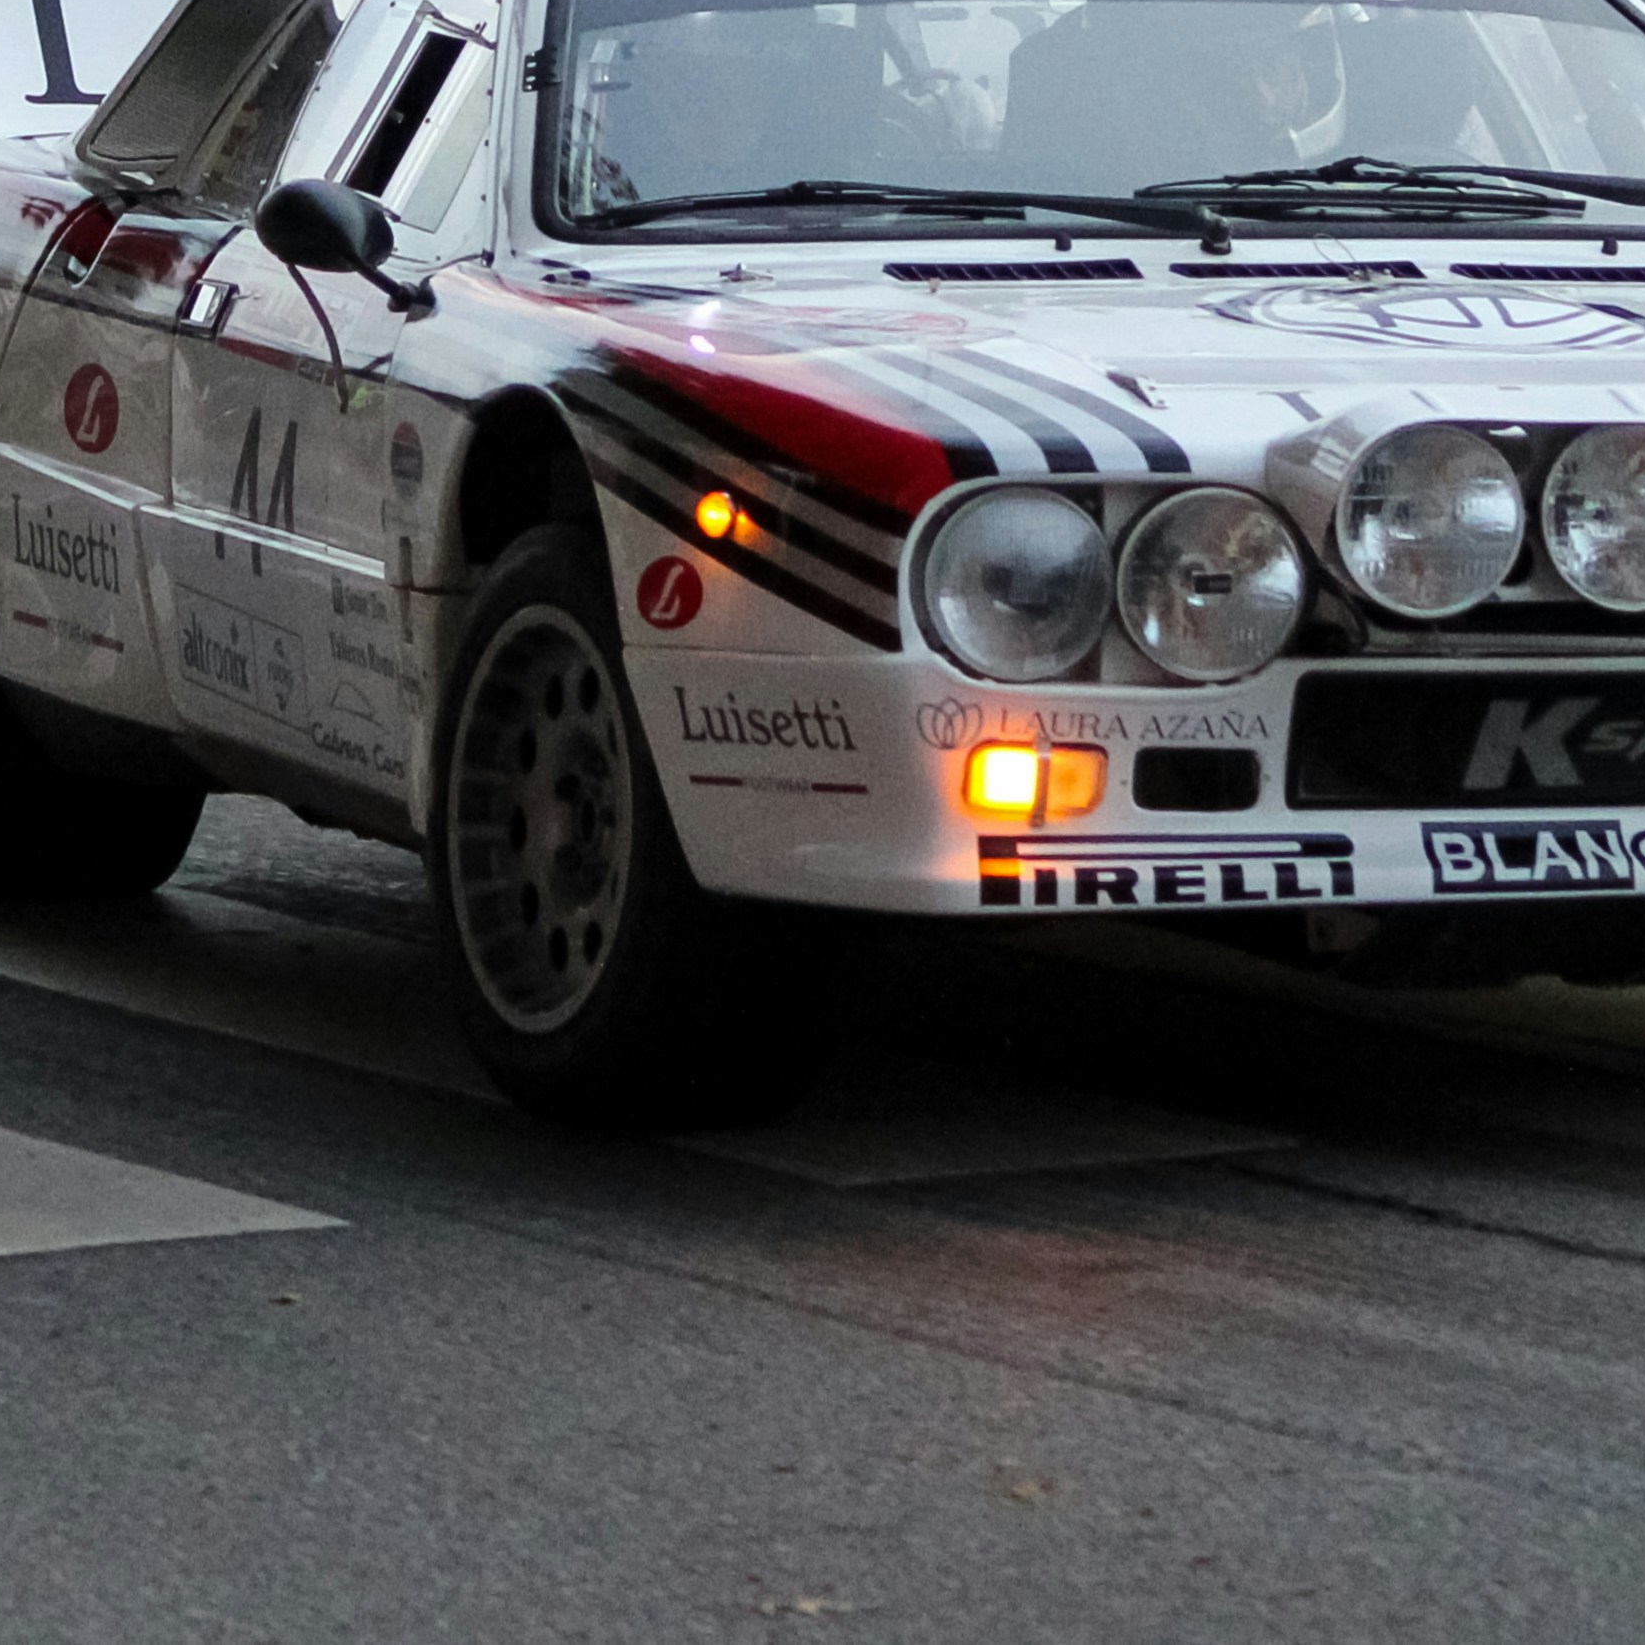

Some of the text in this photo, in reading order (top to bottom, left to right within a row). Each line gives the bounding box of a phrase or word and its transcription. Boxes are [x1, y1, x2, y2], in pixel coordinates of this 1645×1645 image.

[12, 493, 121, 595] Luisetti
[672, 686, 858, 751] Luisetti
[999, 707, 1271, 741] LAURA AZAÑA
[978, 834, 1355, 906] PIRELLI
